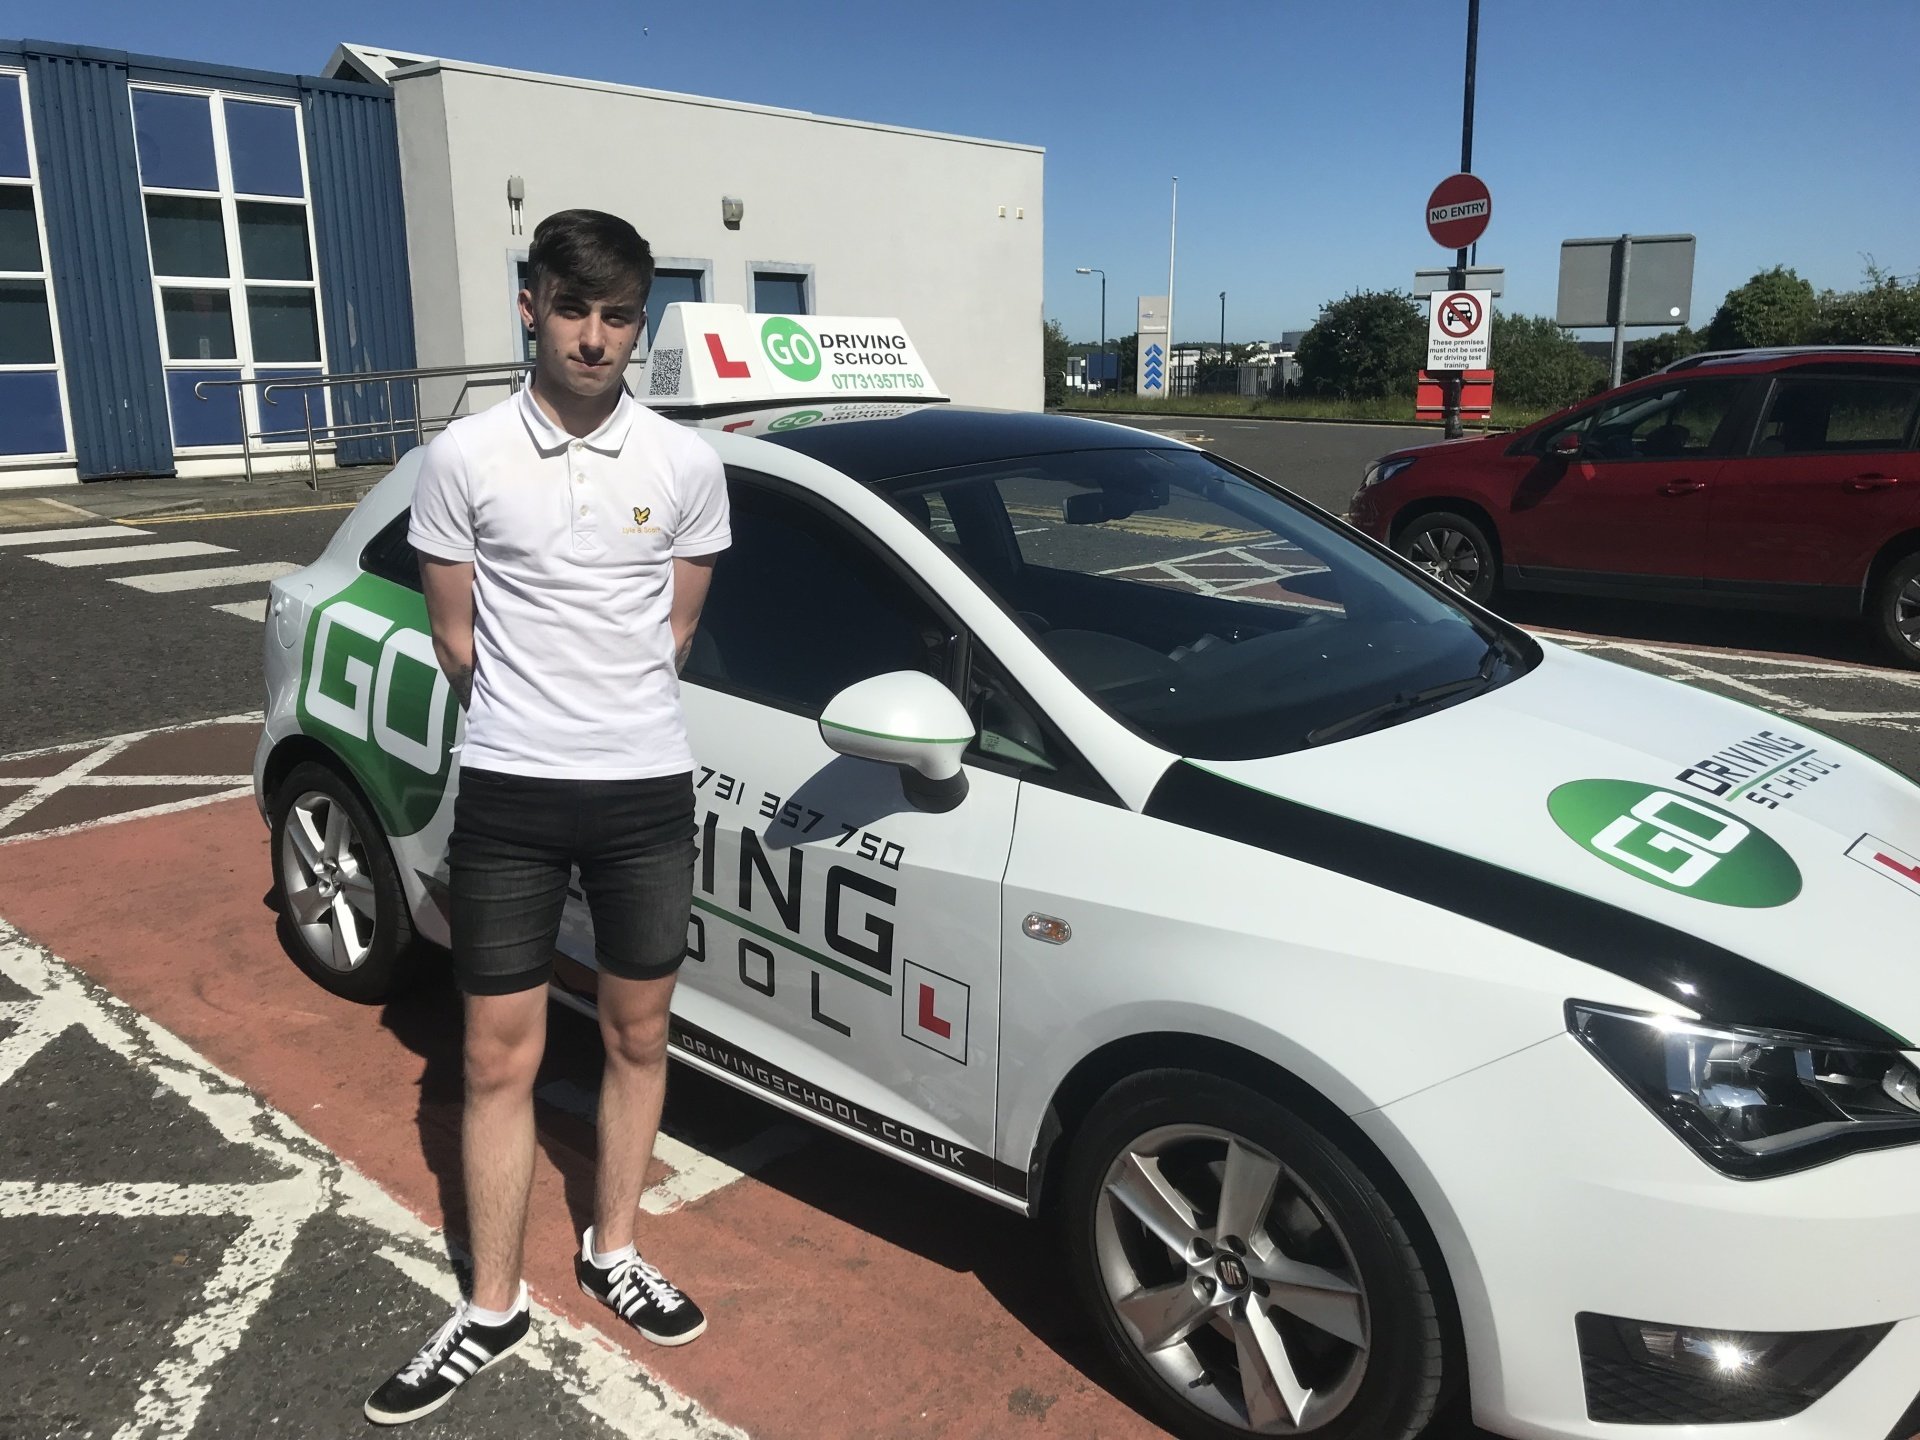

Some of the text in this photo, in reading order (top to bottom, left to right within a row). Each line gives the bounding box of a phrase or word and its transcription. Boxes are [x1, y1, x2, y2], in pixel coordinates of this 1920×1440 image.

[1431, 201, 1485, 221] NO ENTRY
[704, 333, 751, 378] L
[766, 333, 813, 366] GO
[819, 333, 906, 350] DRIVING
[833, 352, 908, 366] SCHOOL
[1444, 354, 1467, 362] driving
[1453, 339, 1484, 347] premises
[831, 373, 924, 390] 07731357750
[305, 600, 450, 775] GO
[1674, 730, 1806, 797] DRIVING
[1745, 757, 1842, 810] SCHOOL
[696, 765, 905, 870] 731 357 750
[1591, 791, 1750, 887] GO
[919, 983, 951, 1039] L
[681, 1033, 966, 1167] DRIVINGSCHOOL.CO.UK
